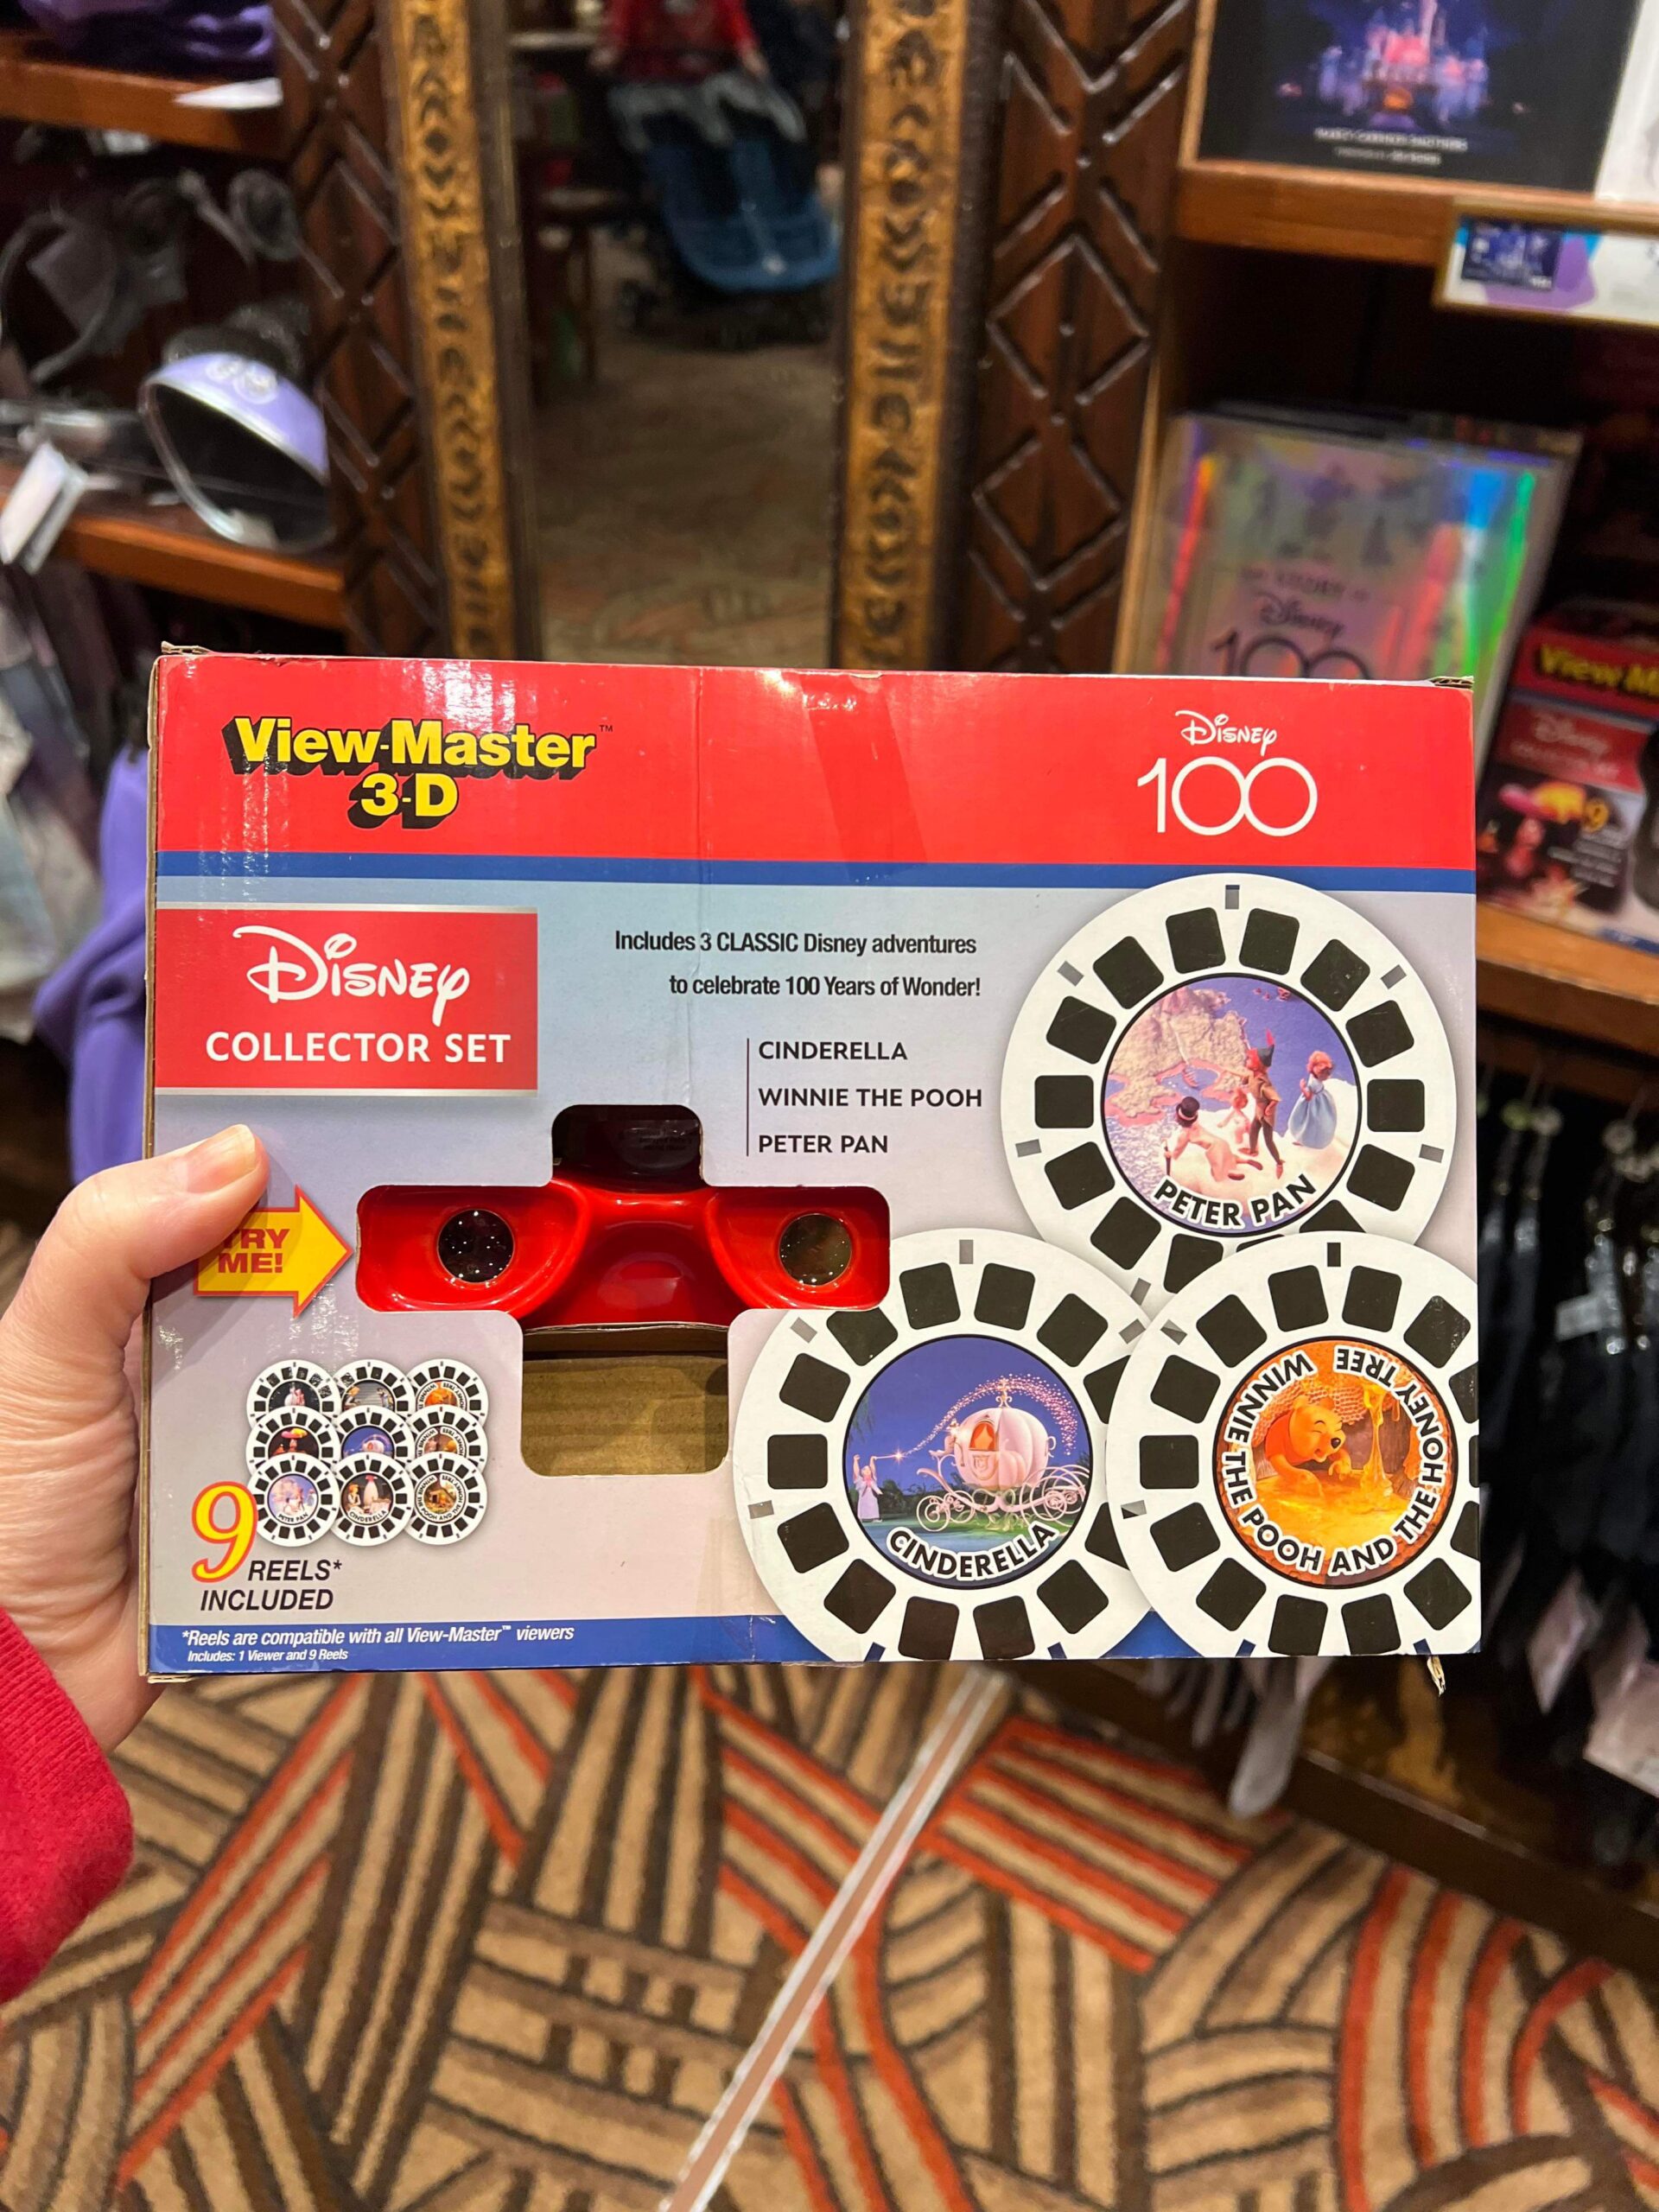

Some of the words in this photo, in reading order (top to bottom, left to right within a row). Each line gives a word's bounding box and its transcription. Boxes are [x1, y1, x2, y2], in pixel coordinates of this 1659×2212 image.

[1175, 710, 1278, 754] Disney
[354, 773, 458, 823] 3-D
[1137, 756, 1319, 836] 100
[615, 930, 696, 951] Includes
[700, 932, 712, 951] 3
[716, 931, 798, 953] CLASSIC
[804, 932, 868, 957] Disney
[872, 934, 977, 954] adventures
[232, 925, 470, 1027] Disney
[669, 975, 689, 995] to
[692, 976, 780, 995] celebrate
[785, 976, 820, 995] 100
[824, 976, 875, 996] Years
[880, 976, 899, 996] of
[902, 976, 981, 996] Wonder!
[206, 1031, 430, 1062] COLLECTOR
[444, 1033, 512, 1063] SET
[759, 1041, 907, 1060] CINDERELLA
[758, 1088, 849, 1107] WINNIE
[855, 1088, 902, 1107] THE
[910, 1089, 982, 1108] POOH
[759, 1135, 832, 1154] PETER
[841, 1135, 888, 1154] PAN
[1154, 1179, 1241, 1226] PETER
[1250, 1173, 1317, 1224] PAN
[218, 1253, 283, 1274] ME!
[1336, 1348, 1397, 1388] TREE
[1228, 1353, 1314, 1445] WINNIE
[1395, 1382, 1445, 1484] HONEY
[1224, 1451, 1254, 1505] THE
[192, 1481, 258, 1583] 9
[296, 1513, 309, 1522] PAN
[349, 1510, 387, 1522] CINDERELLA
[1393, 1490, 1437, 1541] THE
[890, 1523, 1056, 1578] CINDERELLA
[1242, 1507, 1322, 1572] POOH
[1332, 1537, 1395, 1573] AND
[200, 1588, 334, 1611] INCLUDED
[187, 1649, 236, 1662] Includes:
[238, 1649, 245, 1662] 1
[247, 1649, 284, 1662] Viewer
[286, 1649, 306, 1661] and
[308, 1649, 317, 1661] 9
[318, 1649, 349, 1660] Reels
[232, 1631, 257, 1645] are
[261, 1629, 345, 1648] compatible
[348, 1628, 382, 1644] with
[384, 1628, 404, 1643] all
[516, 1625, 575, 1641] viewers
